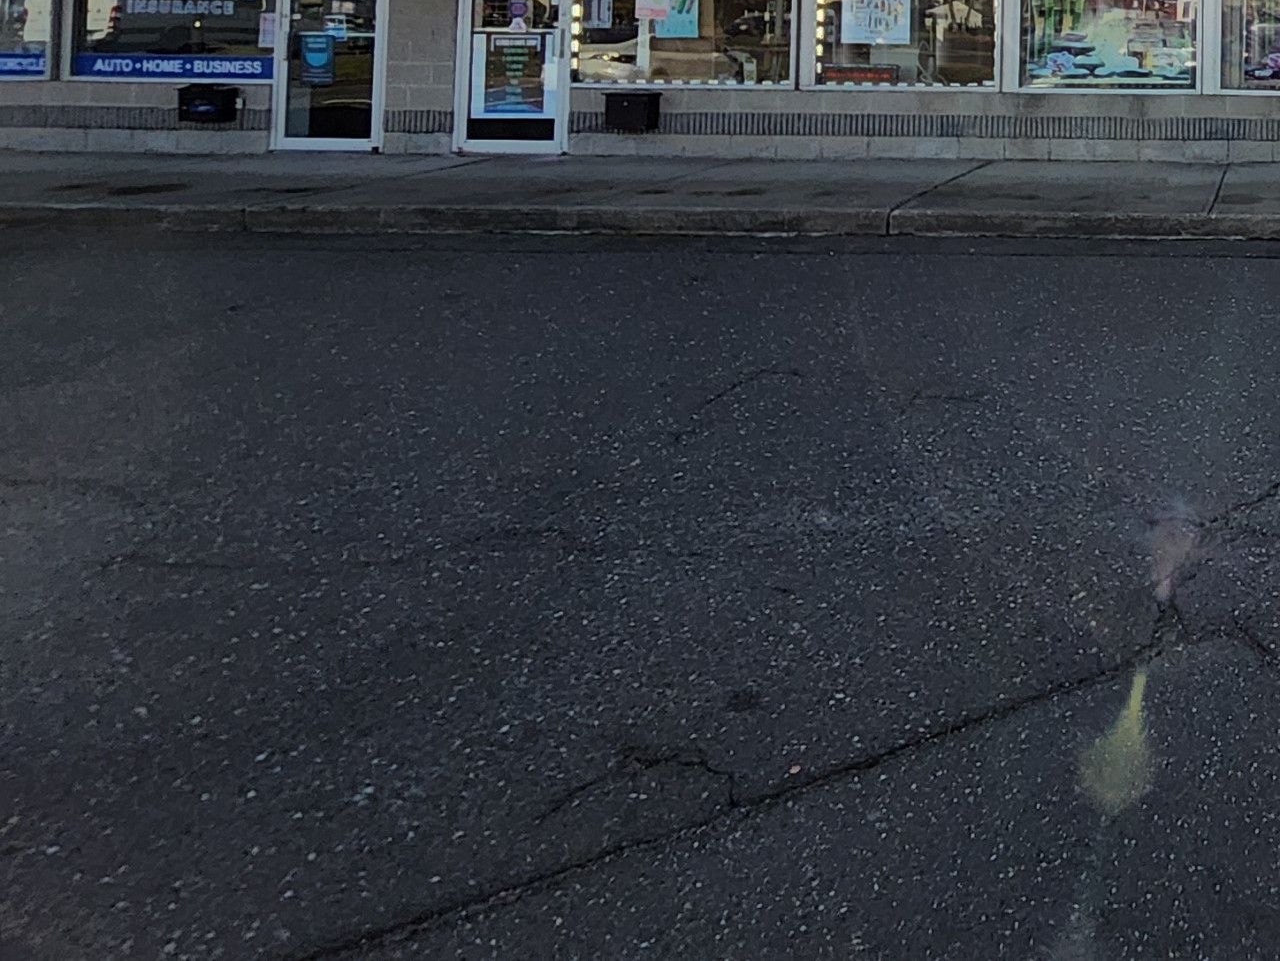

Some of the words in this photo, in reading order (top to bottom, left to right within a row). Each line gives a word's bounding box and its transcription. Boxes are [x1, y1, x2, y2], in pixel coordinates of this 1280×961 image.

[126, 0, 235, 15] INSURANCE
[93, 58, 133, 72] AUTO
[142, 59, 183, 73] HOME
[193, 60, 262, 74] BUSINESS
